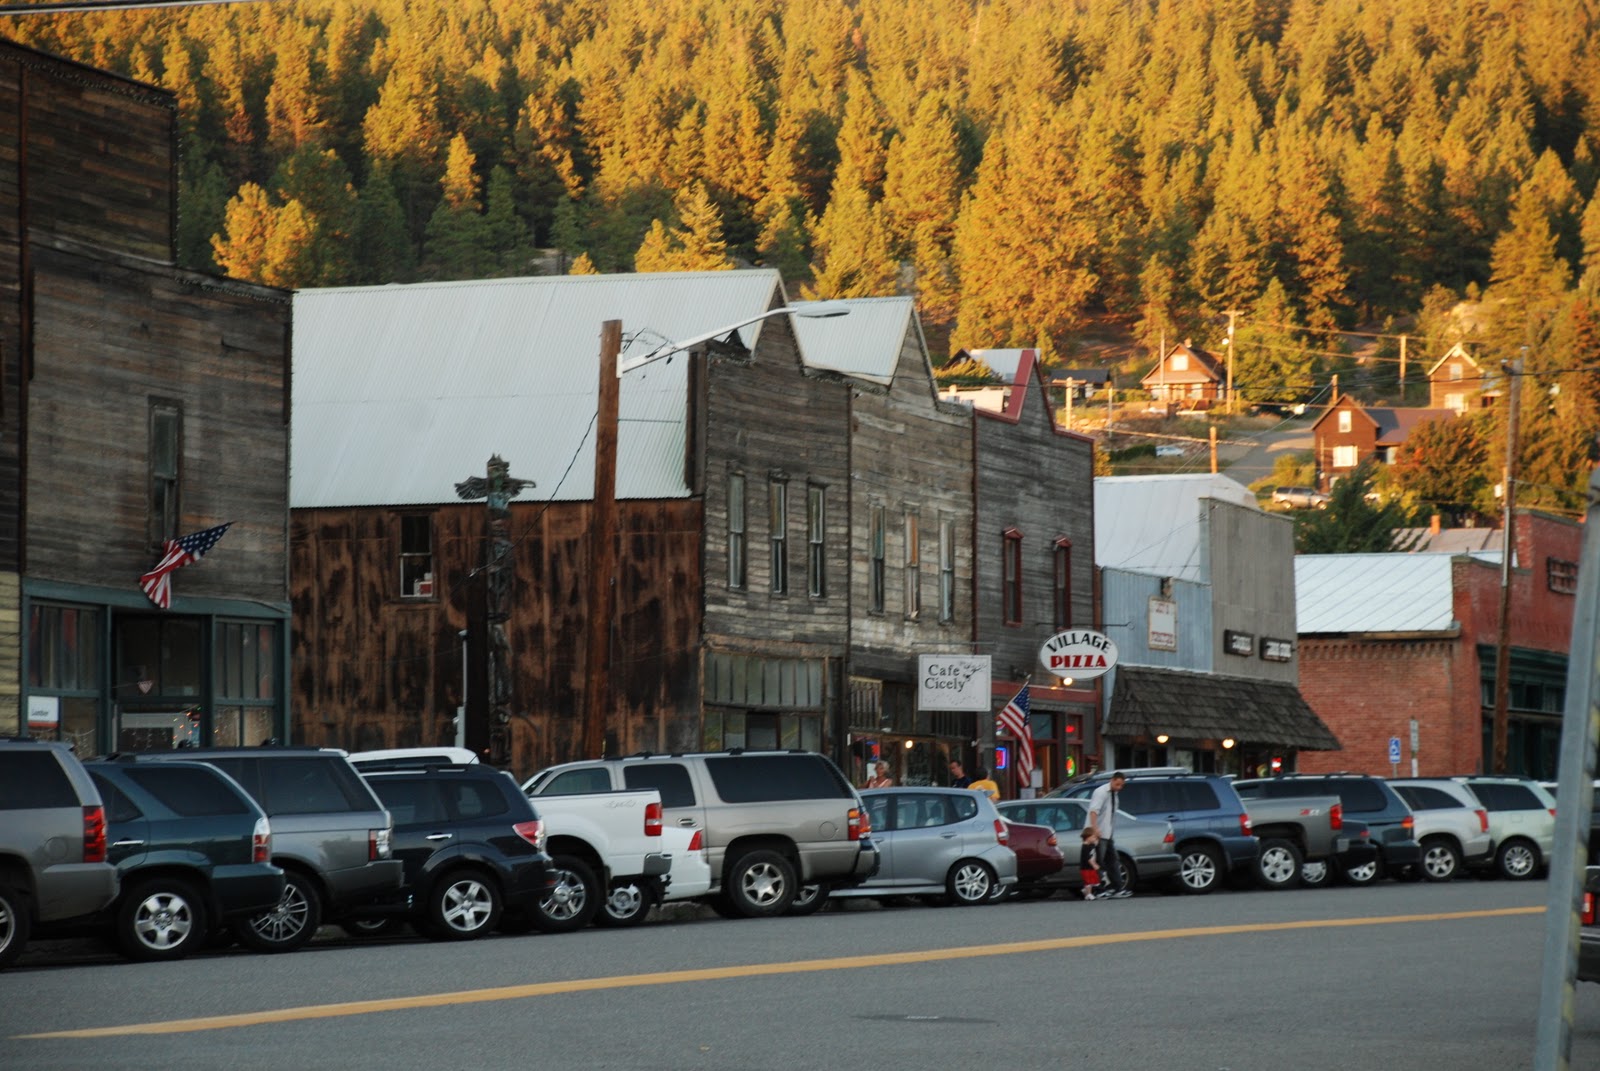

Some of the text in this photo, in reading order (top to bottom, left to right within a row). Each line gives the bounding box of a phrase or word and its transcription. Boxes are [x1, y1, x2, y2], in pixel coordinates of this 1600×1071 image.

[1046, 632, 1112, 653] VILLAGE
[1050, 654, 1107, 668] PIZZA
[928, 664, 960, 676] Cafe
[924, 677, 965, 692] Cicely
